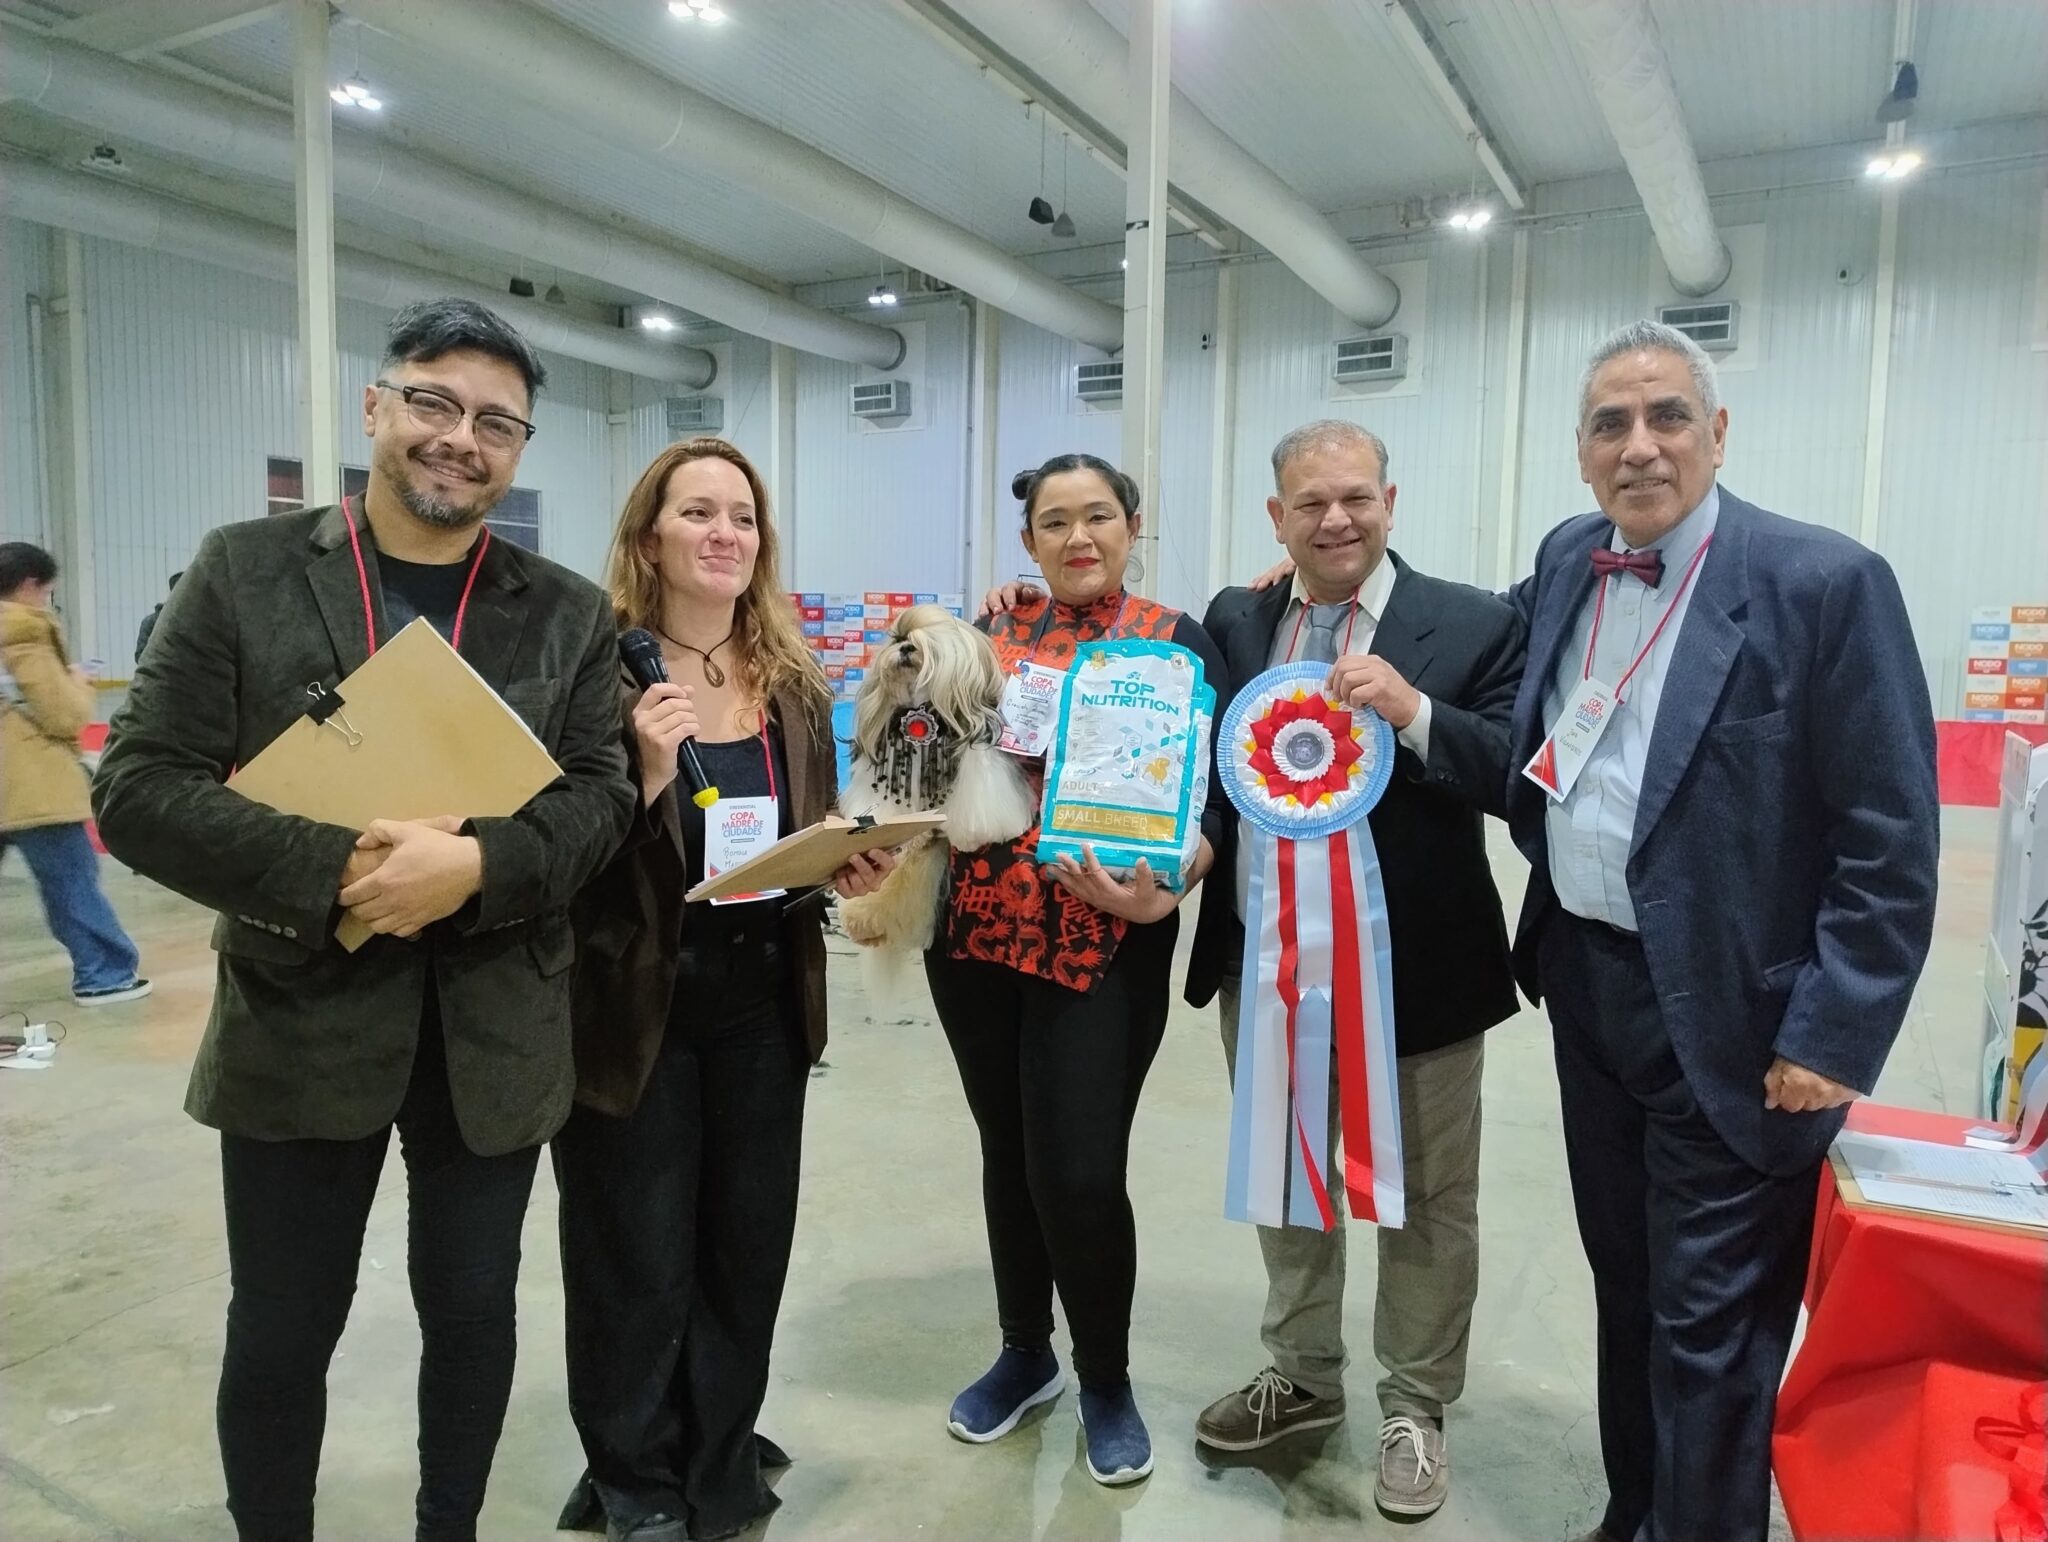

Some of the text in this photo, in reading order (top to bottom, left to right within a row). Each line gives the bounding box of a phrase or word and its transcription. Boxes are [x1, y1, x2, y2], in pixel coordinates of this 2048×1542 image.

[1031, 676, 1053, 686] COPA
[1020, 681, 1059, 694] MADRE DE
[1020, 687, 1055, 699] CIUDADES
[1110, 679, 1156, 696] TOP
[1081, 693, 1180, 716] NUTRITION
[1589, 697, 1604, 712] COPA
[1062, 781, 1099, 791] ADULT
[730, 811, 755, 820] COPA
[1057, 809, 1148, 830] SMALL BREED
[722, 820, 764, 830] MADRE DE
[723, 828, 762, 838] CIUDADES
